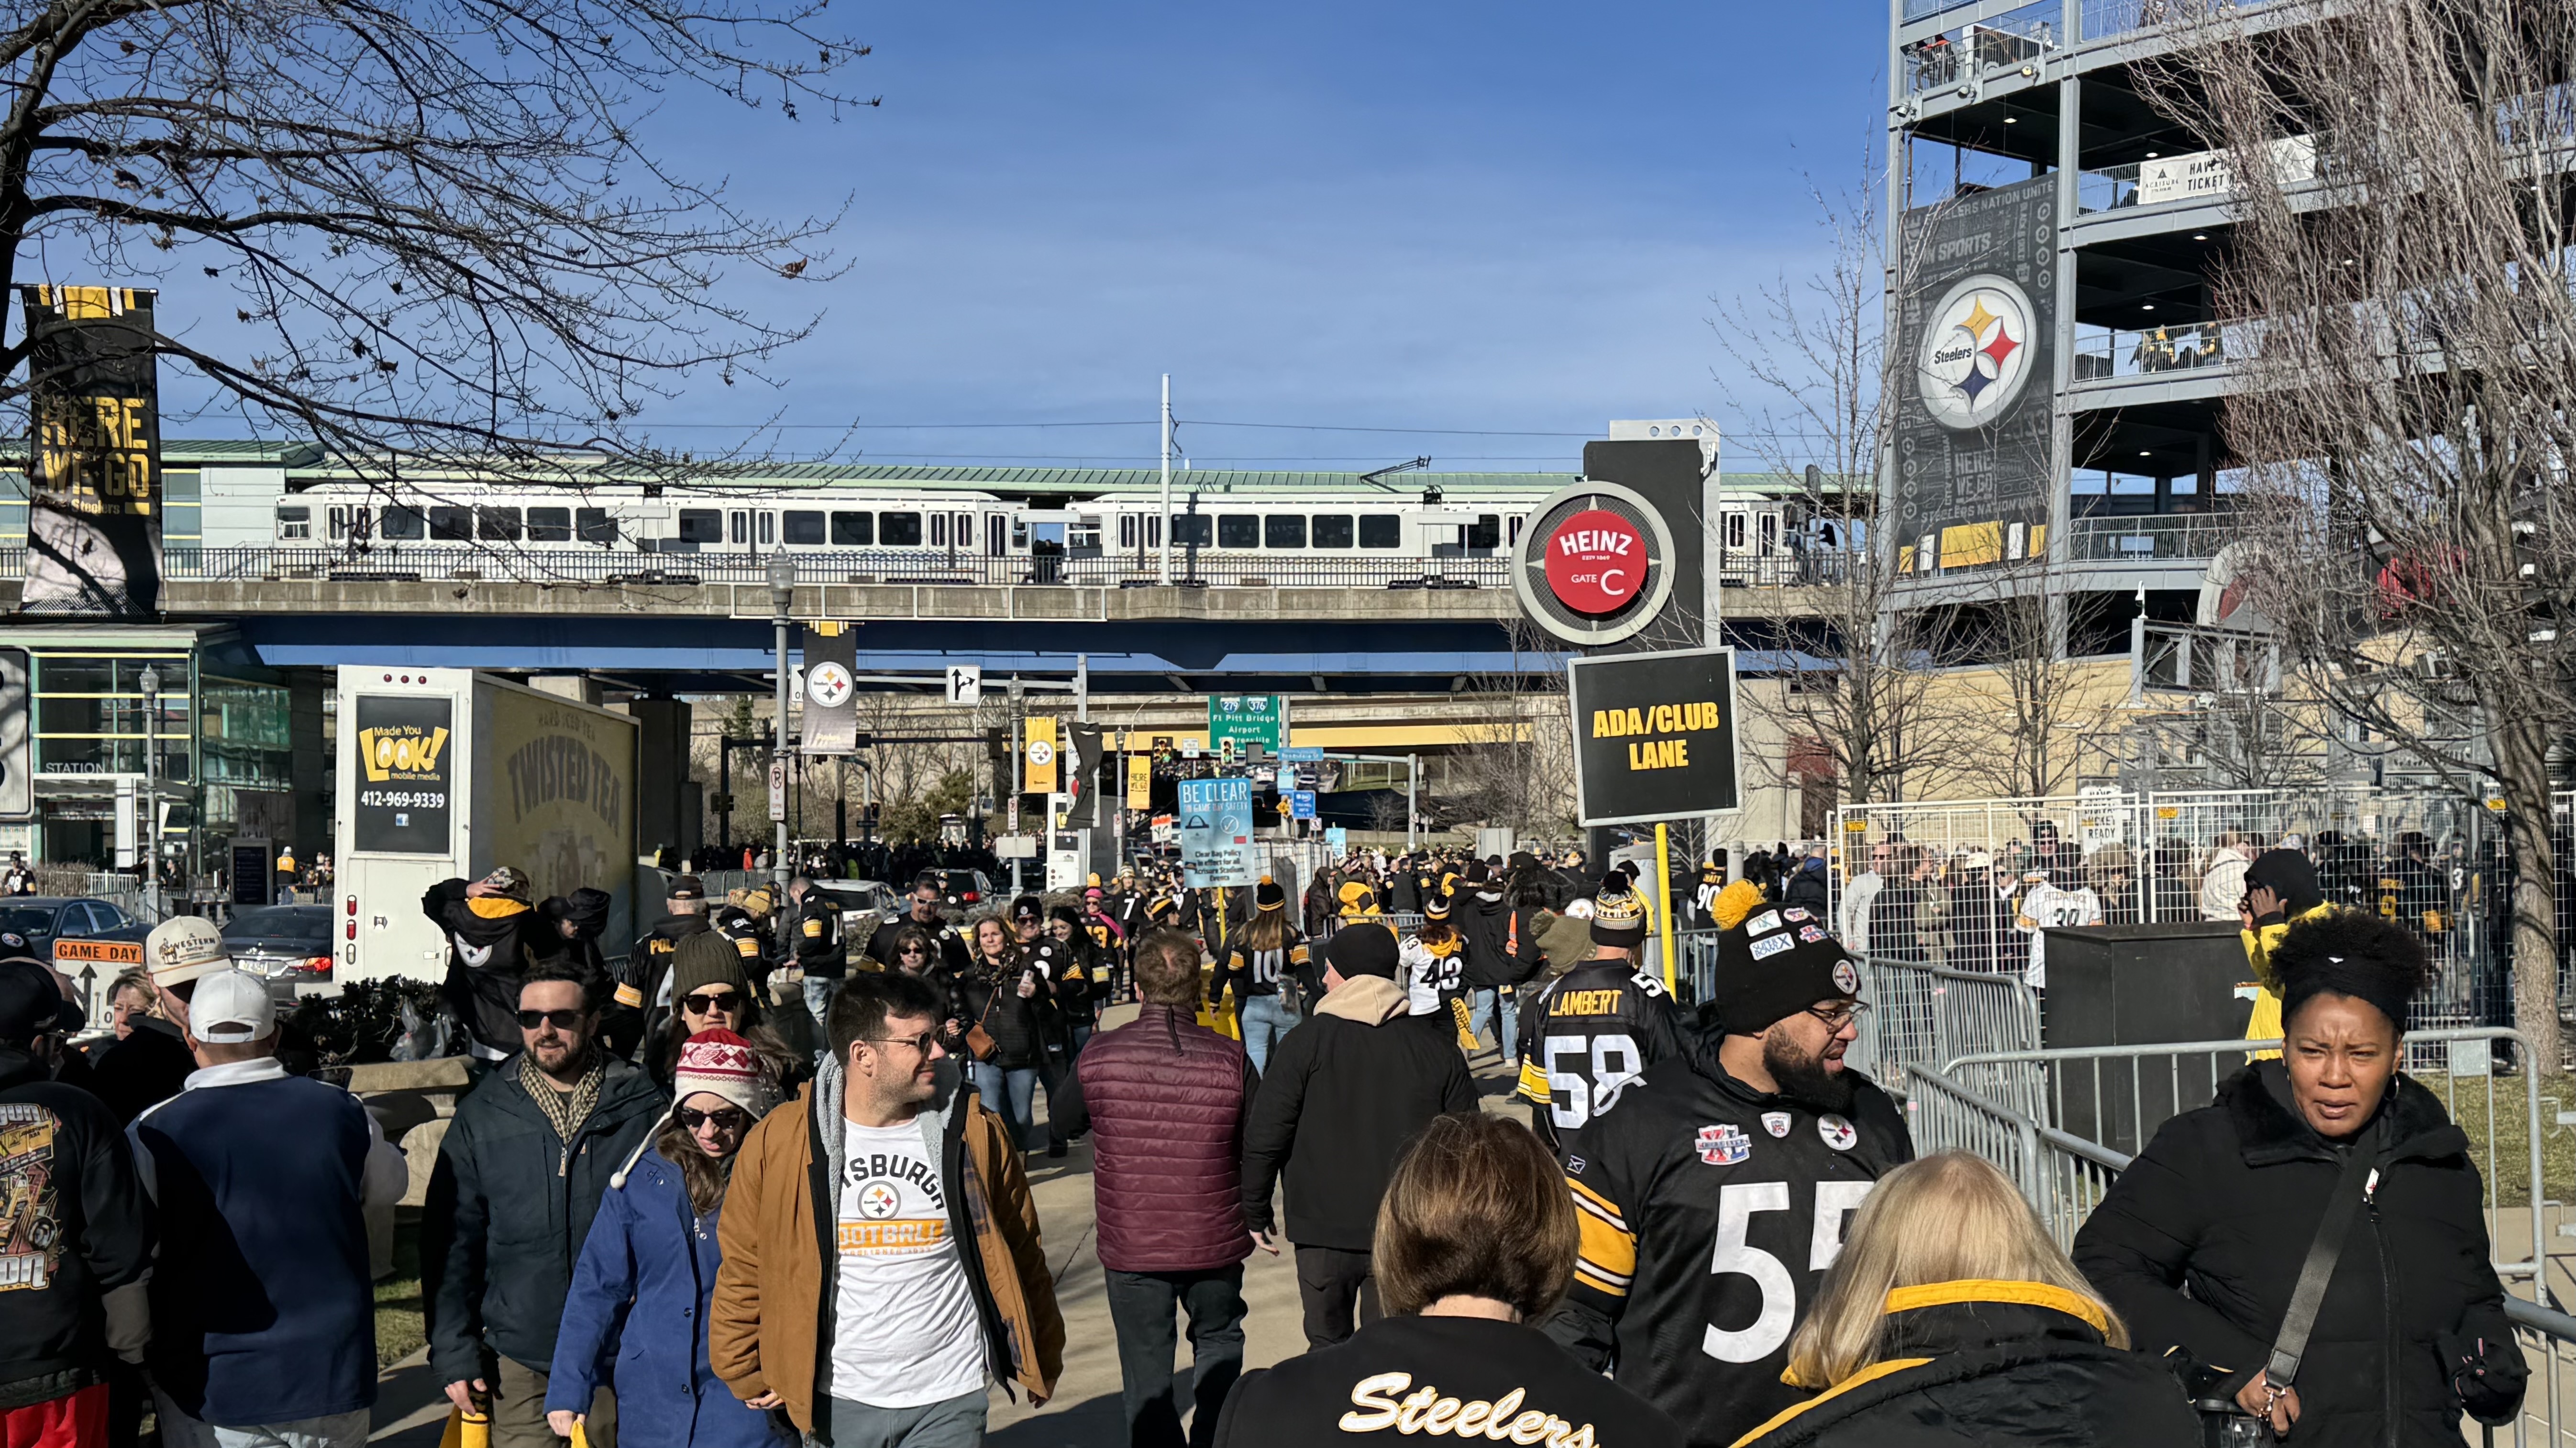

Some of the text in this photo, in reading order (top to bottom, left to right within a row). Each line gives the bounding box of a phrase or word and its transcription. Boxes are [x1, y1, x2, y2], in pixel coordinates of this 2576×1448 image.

[1981, 193, 2020, 210] NATION
[2023, 180, 2055, 200] UNITE
[2188, 175, 2224, 191] TICKET
[1938, 231, 1991, 262] SPORTS
[1934, 347, 1972, 364] Steelers
[42, 396, 148, 449] HERE
[43, 450, 149, 497] WE GO
[1955, 450, 1993, 476] HERE
[1956, 472, 1993, 496] WE GO
[72, 498, 120, 515] Steelers
[1559, 530, 1633, 556] HEINZ
[1571, 569, 1624, 595] GATE C
[1224, 701, 1238, 711] 279
[1250, 701, 1265, 711] 376
[374, 725, 421, 736] Made You
[1246, 714, 1275, 723] Bridge
[1593, 702, 1719, 738] ADA/CLUB
[359, 726, 449, 781] LOOK!
[1629, 739, 1689, 770] LANE
[45, 762, 106, 773] STATION
[508, 735, 621, 838] TWISTED TEA
[1183, 782, 1247, 803] BE CLEAR
[361, 790, 445, 808] 412-969-9339
[2089, 828, 2115, 839] READY
[2453, 868, 2464, 889] 3
[1123, 898, 1135, 920] 7
[1697, 884, 1721, 911] 90
[59, 943, 138, 961] GAME DAY
[650, 938, 678, 955] POL
[1777, 934, 1791, 950] X
[1253, 946, 1283, 984] 10
[1420, 956, 1463, 991] 43
[1549, 989, 1622, 1017] LAMBERT
[1544, 1034, 1647, 1130] 58
[839, 1223, 936, 1246] OOTBALL
[1338, 1371, 1600, 1448] Steelers
